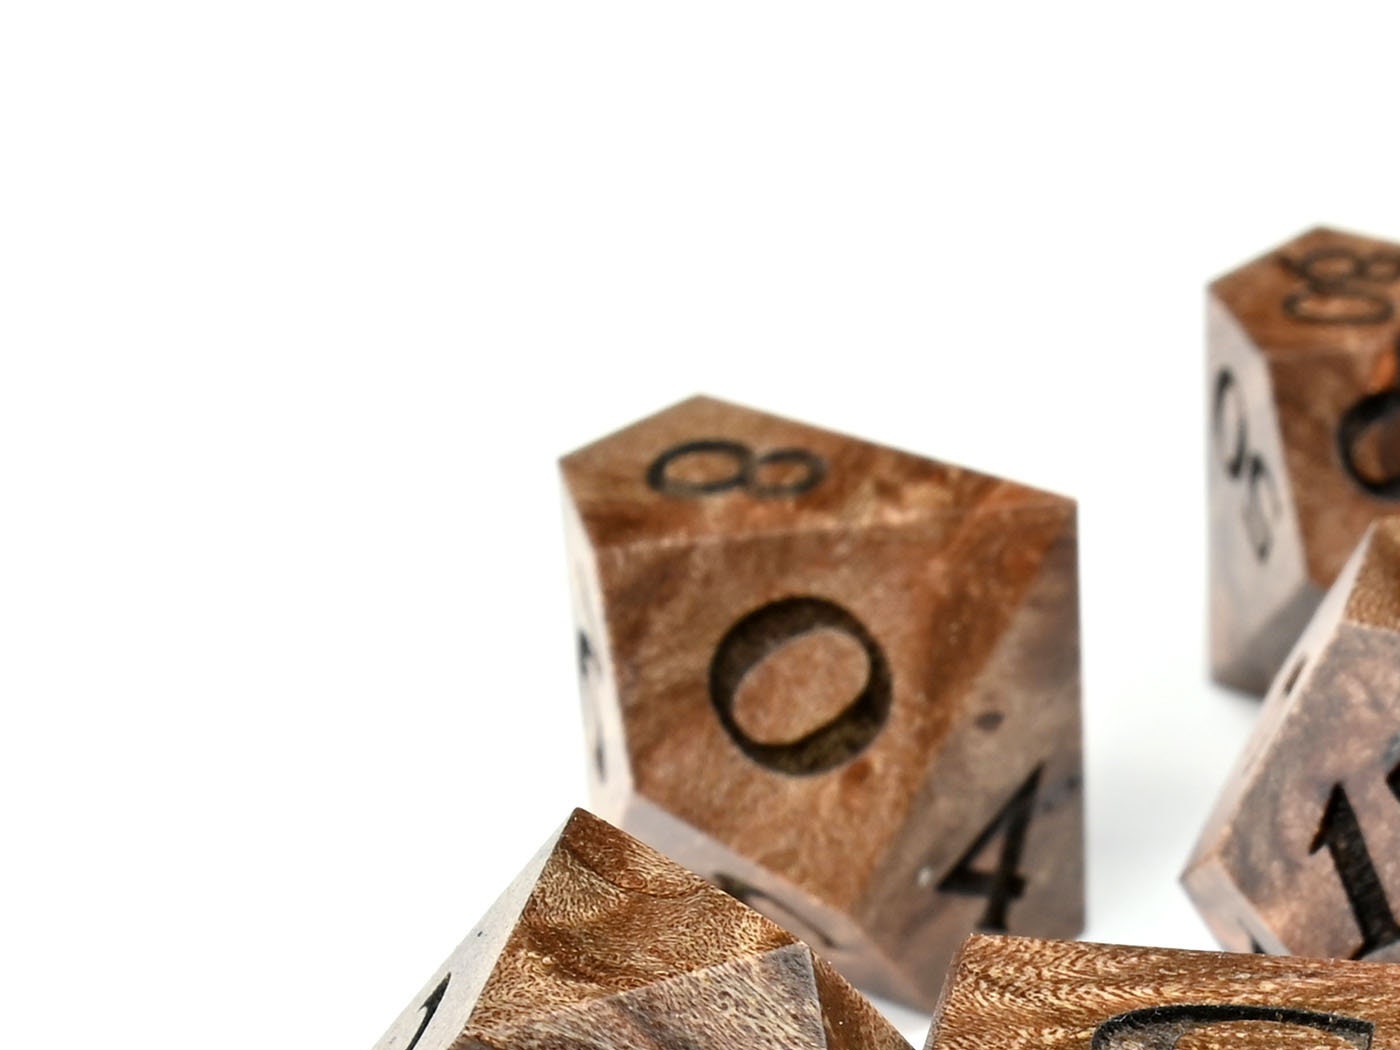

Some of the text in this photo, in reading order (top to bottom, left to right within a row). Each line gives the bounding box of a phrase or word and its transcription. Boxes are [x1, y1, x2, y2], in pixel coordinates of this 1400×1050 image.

[646, 439, 829, 498] 8
[708, 595, 893, 777] 0
[936, 761, 1046, 932] 4
